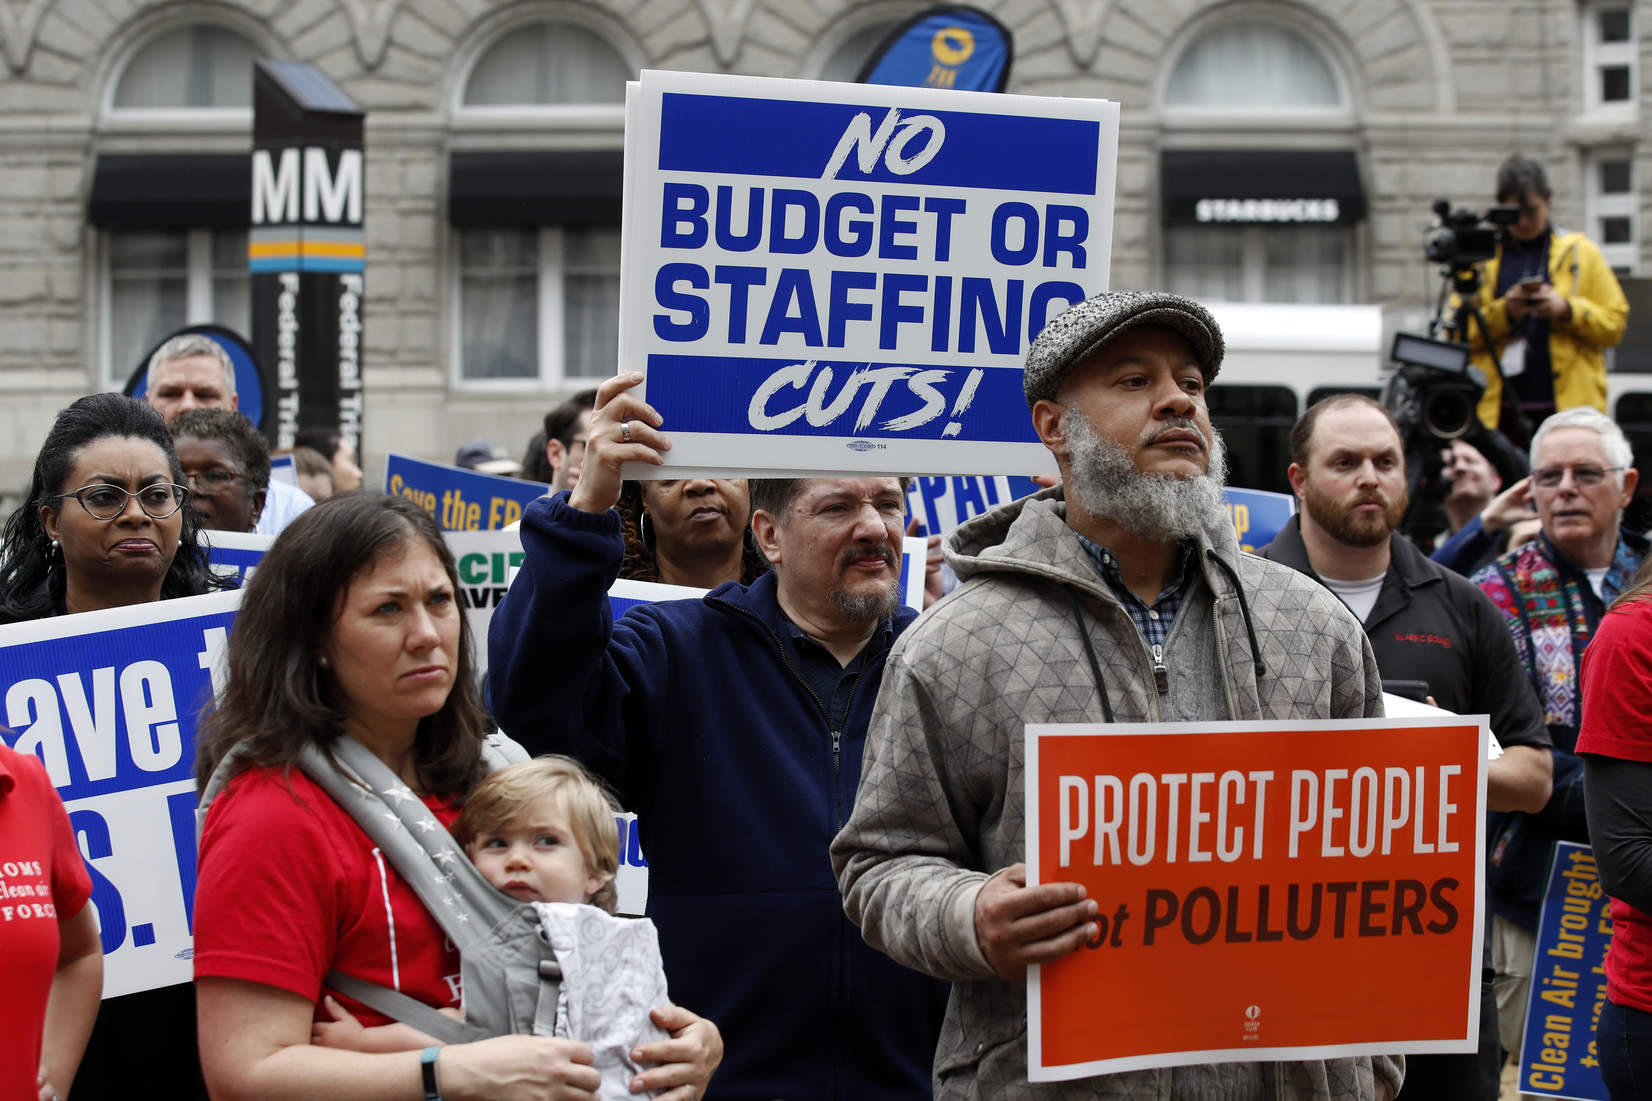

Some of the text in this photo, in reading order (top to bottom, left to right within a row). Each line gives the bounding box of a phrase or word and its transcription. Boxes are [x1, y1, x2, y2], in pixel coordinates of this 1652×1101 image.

[821, 106, 946, 180] NO
[660, 182, 1090, 269] BUDGET OR
[1196, 199, 1339, 222] STARBUCKS
[278, 273, 299, 389] Federal
[339, 273, 363, 389] Federal
[748, 359, 984, 438] CUTS!
[442, 489, 481, 531] the
[0, 660, 182, 787] ave
[1059, 765, 1461, 867] PROTECT PEOPLE
[0, 861, 42, 878] OMS
[1085, 877, 1460, 949] ot POLLUTERS
[1529, 850, 1603, 1091] Clean Air brought
